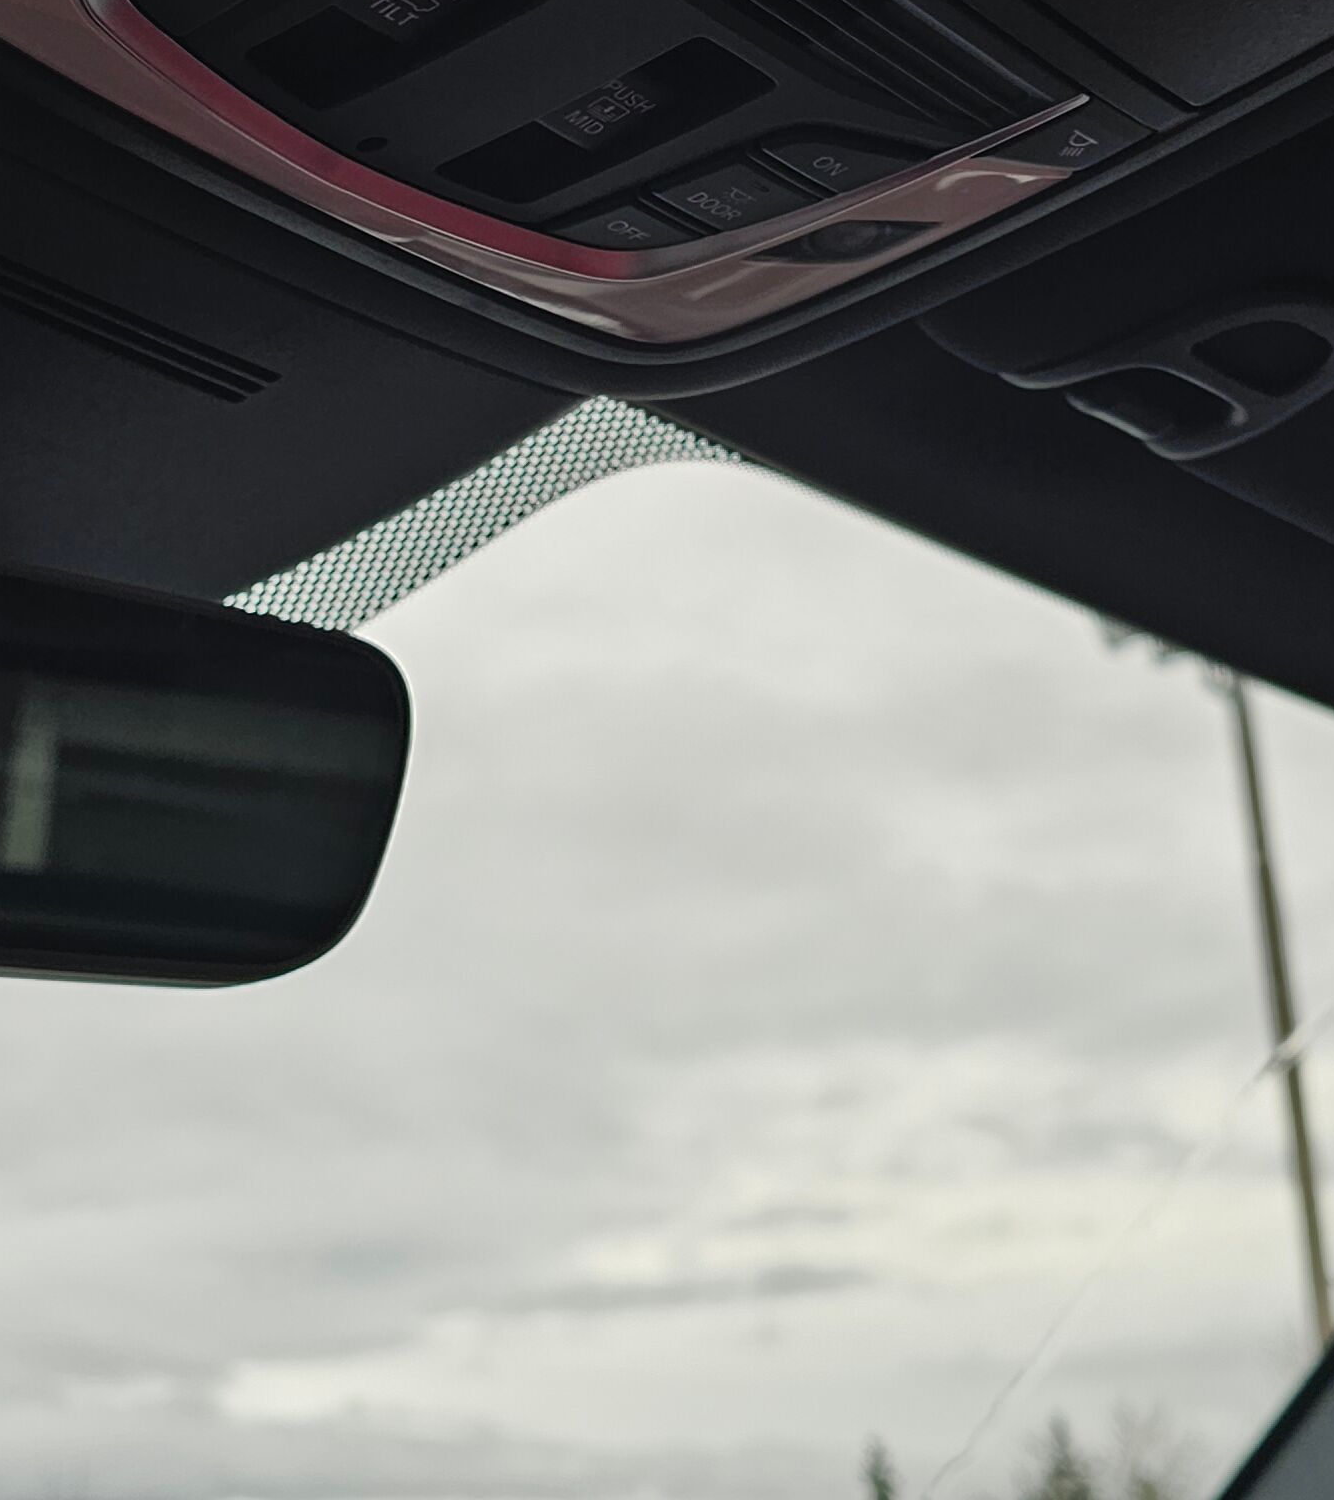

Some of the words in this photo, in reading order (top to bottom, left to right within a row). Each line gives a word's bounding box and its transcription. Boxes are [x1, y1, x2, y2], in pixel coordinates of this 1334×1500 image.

[602, 80, 657, 114] PUSH
[564, 110, 605, 135] MID
[812, 156, 849, 177] ON
[687, 191, 742, 221] DOOR
[606, 220, 652, 241] OFF
